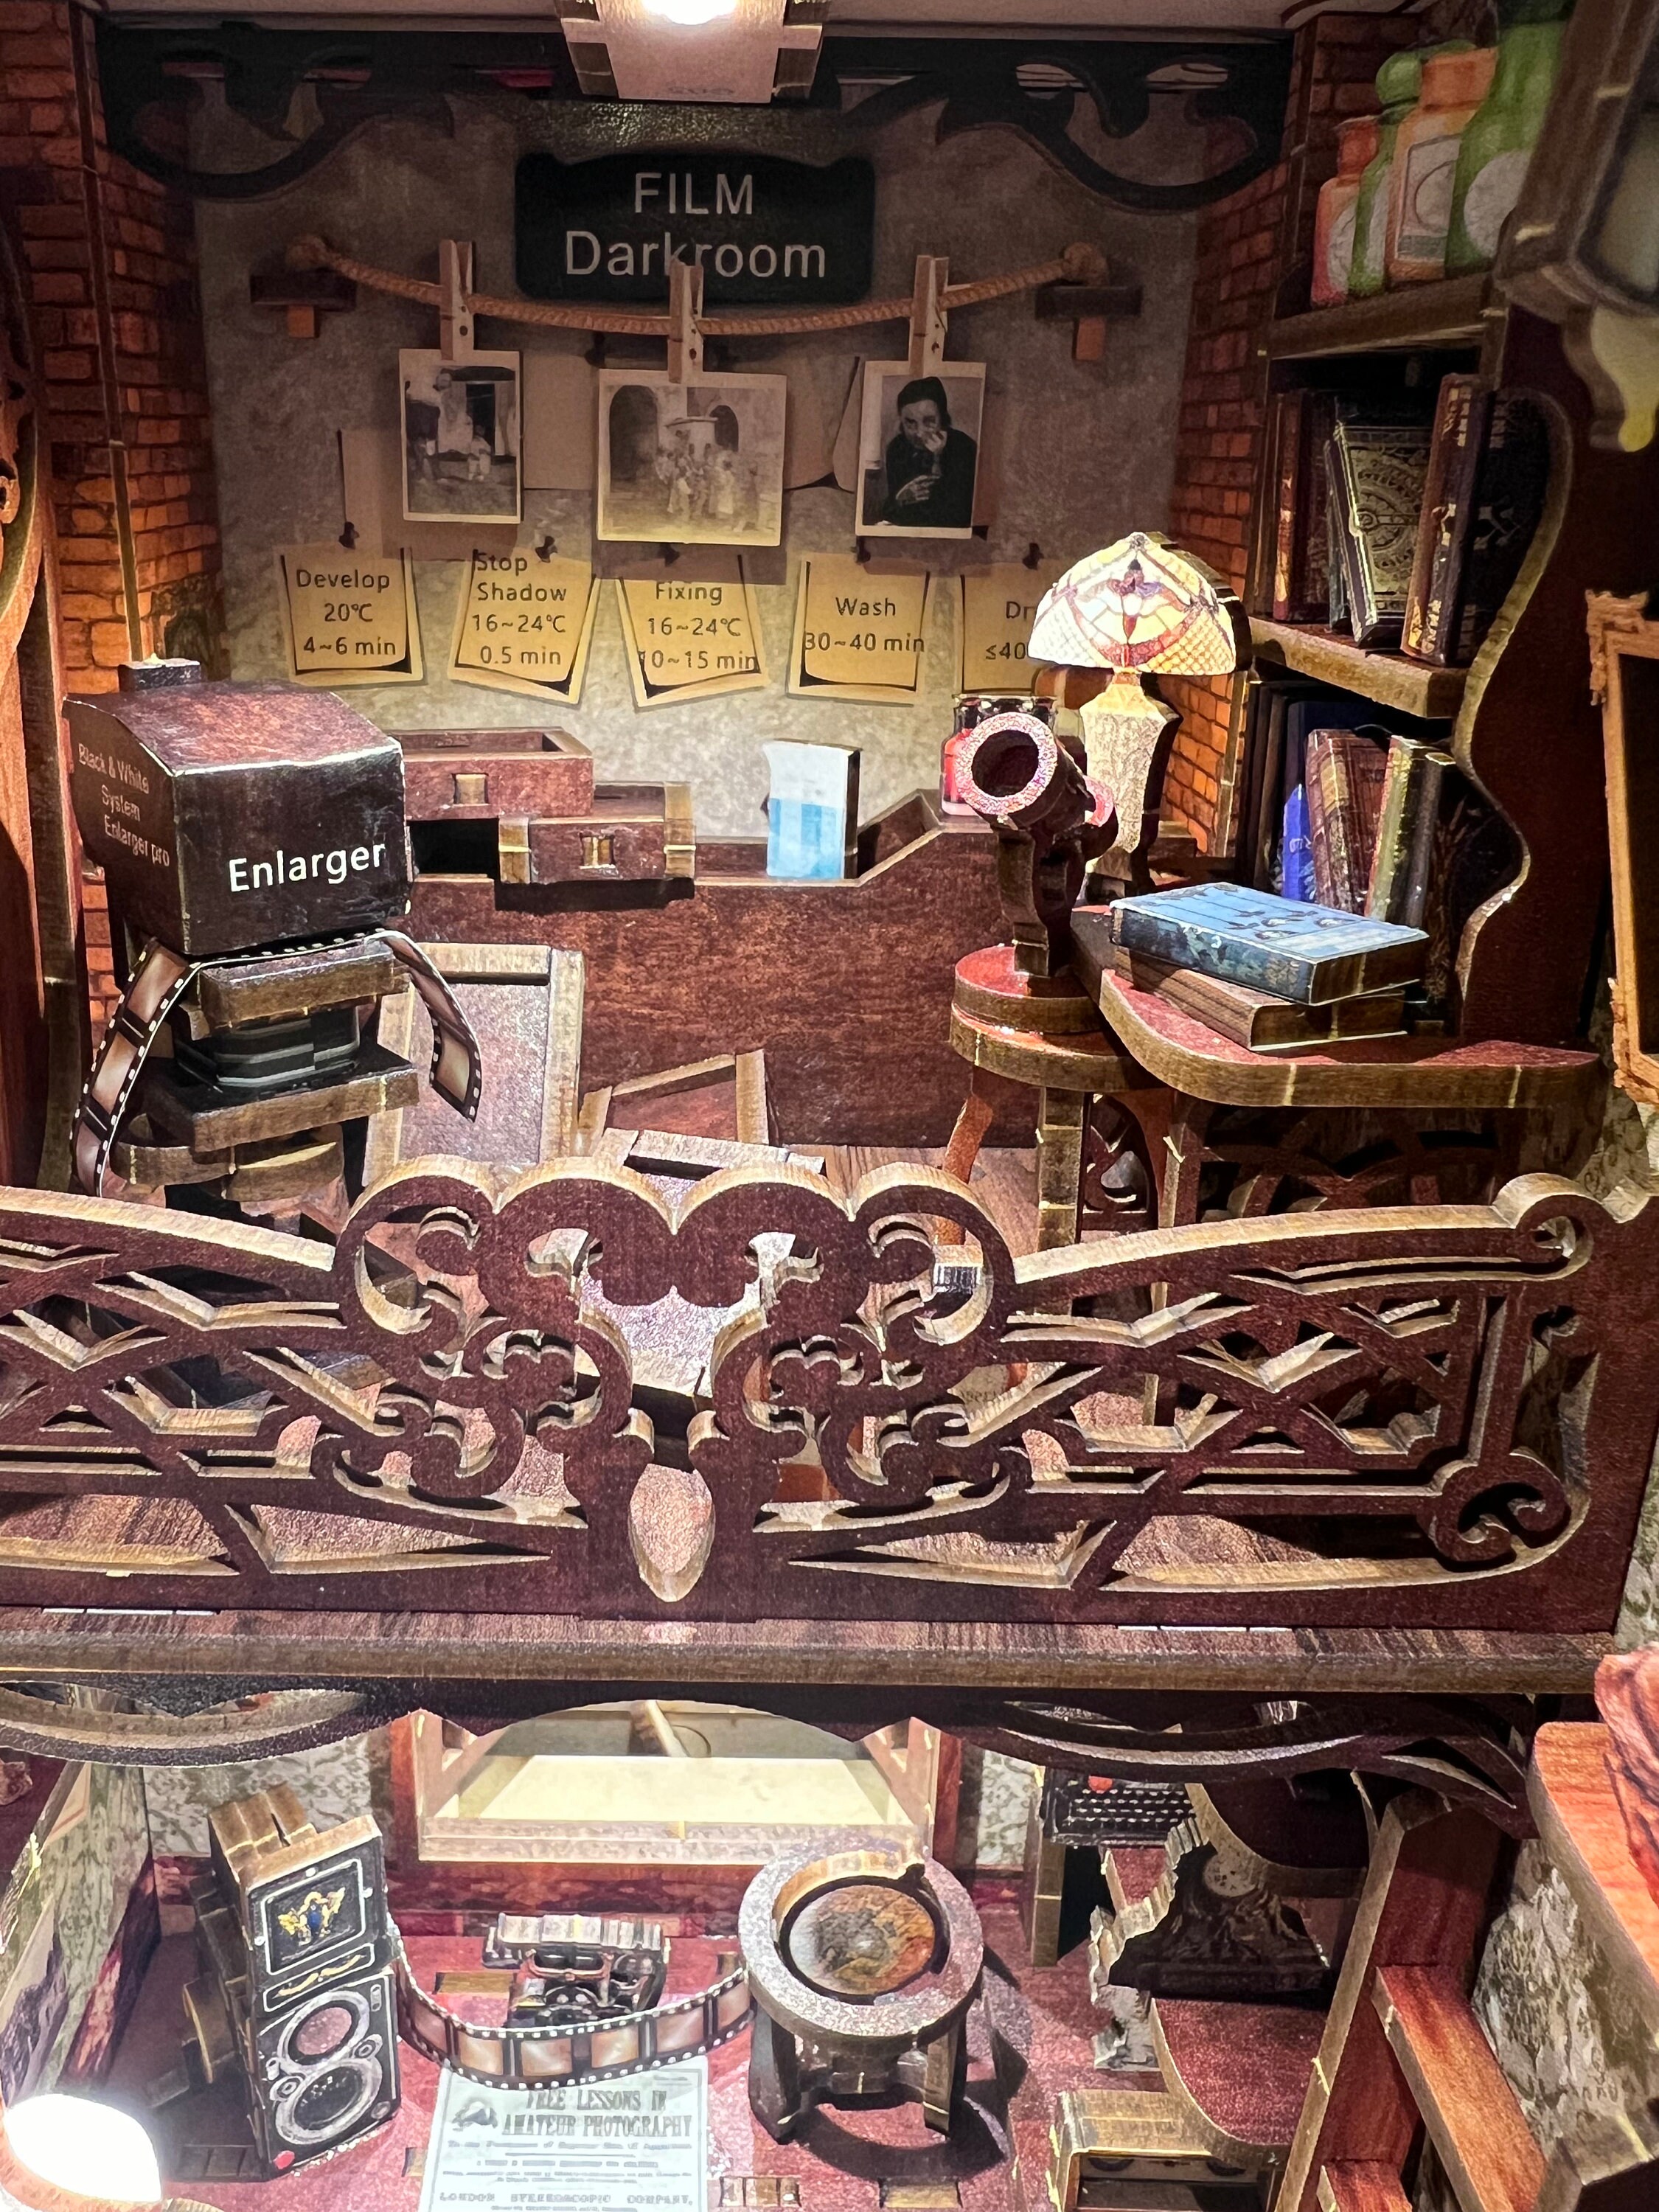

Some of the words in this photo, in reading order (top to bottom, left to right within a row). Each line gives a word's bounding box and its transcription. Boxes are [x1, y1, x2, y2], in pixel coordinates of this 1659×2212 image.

[635, 172, 753, 215] FILM
[566, 231, 826, 278] Darkroom
[476, 552, 527, 576] Stop
[296, 569, 390, 593] Develop
[477, 582, 567, 602] Shadow
[656, 582, 722, 605] Fixing
[324, 603, 373, 622] 20°C
[835, 597, 897, 617] Wash
[1006, 601, 1036, 620] Dr
[304, 637, 348, 655] 4~6
[355, 637, 396, 655] min
[804, 633, 876, 651] 30~40
[884, 633, 925, 652] min
[480, 645, 511, 664] 0.5
[521, 646, 561, 665] min
[717, 650, 757, 670] min
[78, 743, 107, 774] Black
[108, 756, 116, 779] &
[117, 760, 149, 794] White
[101, 785, 140, 821] System
[104, 814, 148, 856] Enlarger
[151, 844, 170, 867] pro
[229, 844, 385, 892] Enlarger
[577, 2089, 641, 2111] LESSONS
[583, 2115, 692, 2137] PHOTOGRAPHY
[439, 2192, 495, 2202] LONDON
